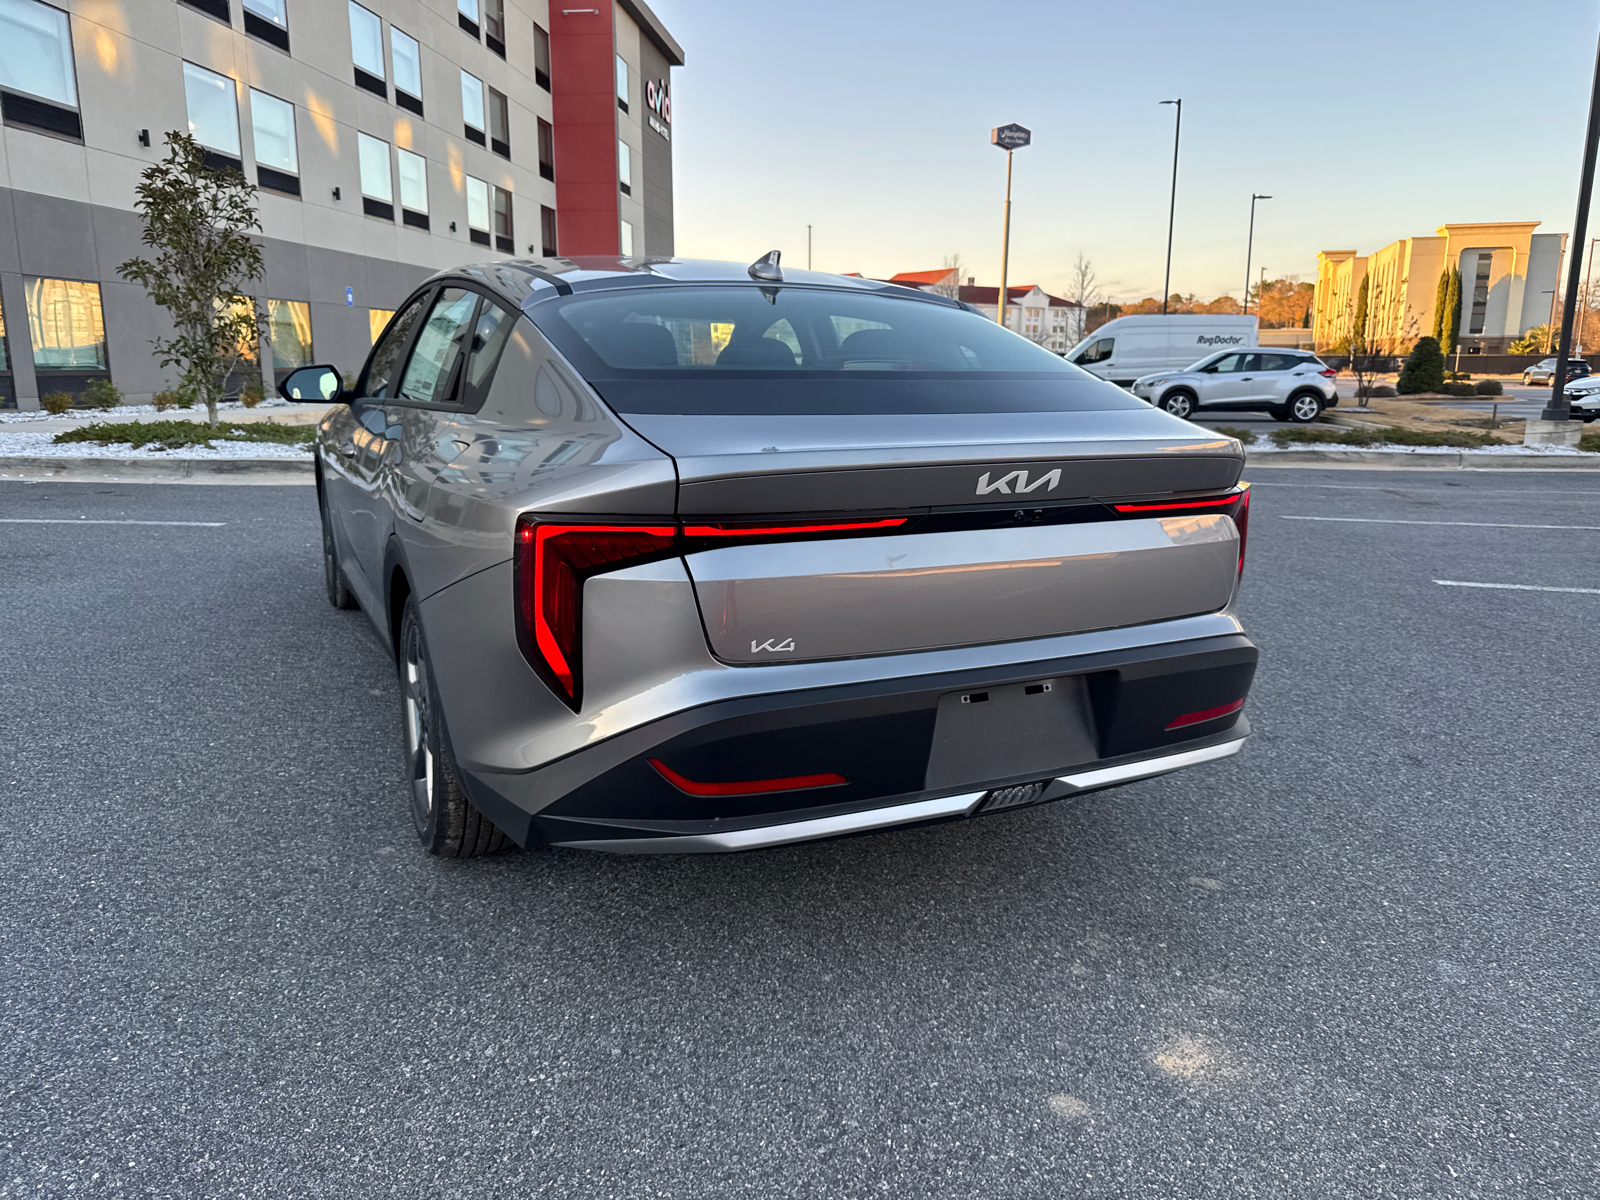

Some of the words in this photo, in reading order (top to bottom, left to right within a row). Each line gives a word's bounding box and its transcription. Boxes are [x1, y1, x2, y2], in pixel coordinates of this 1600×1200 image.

[647, 79, 671, 124] avid
[975, 469, 1062, 495] KIA
[751, 638, 795, 653] K4
